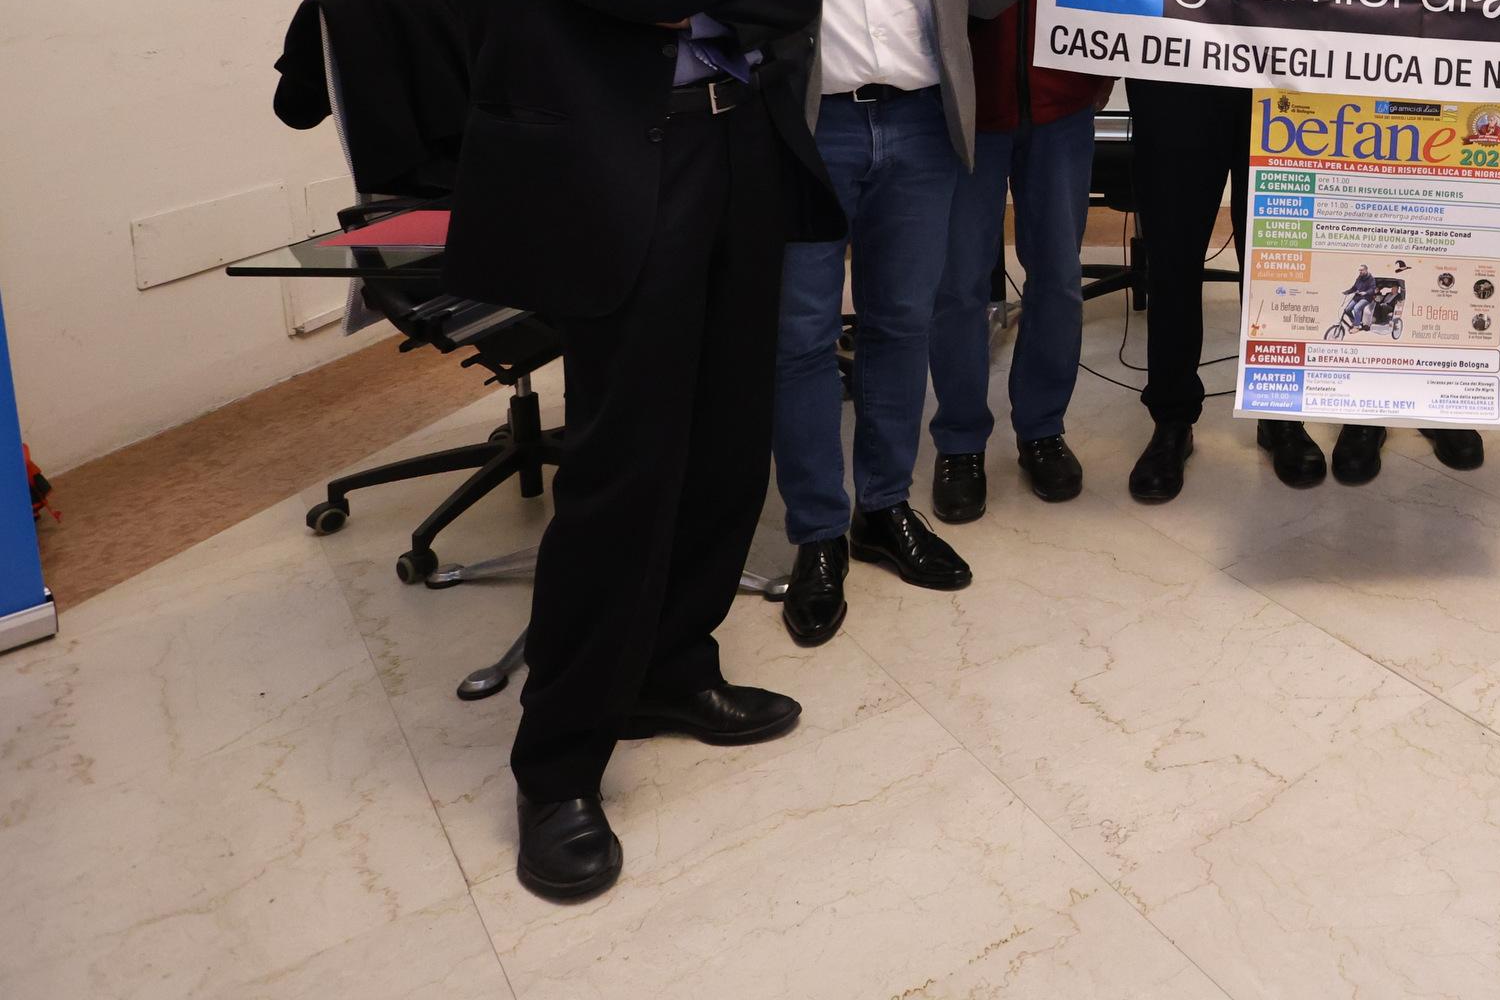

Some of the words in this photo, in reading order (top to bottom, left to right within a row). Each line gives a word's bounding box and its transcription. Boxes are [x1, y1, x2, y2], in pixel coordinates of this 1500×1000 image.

[1050, 25, 1130, 62] CASA
[1141, 35, 1191, 67] DEI
[1202, 41, 1335, 80] RISVEGLI
[1344, 51, 1423, 84] LUCA
[1433, 56, 1473, 88] DE
[1258, 98, 1457, 163] befane
[1268, 158, 1323, 169] SOLIDARIETÀ
[1325, 162, 1342, 170] PER
[1344, 163, 1355, 171] LA
[1357, 164, 1380, 173] CASA
[1381, 166, 1396, 174] DEI
[1398, 167, 1436, 176] RISVEGLI
[1438, 168, 1460, 177] LUCA
[1461, 169, 1473, 177] DE
[1261, 172, 1311, 183] DOMENICA
[1260, 182, 1266, 190] 4
[1267, 183, 1311, 192] GENNAIO
[1358, 187, 1397, 195] RISVEGLI
[1398, 189, 1420, 197] LUCA
[1422, 190, 1434, 198] DE
[1435, 190, 1464, 199] NIGRIS
[1267, 197, 1302, 207] LUNEDÌ
[1258, 207, 1264, 215] 5
[1266, 207, 1309, 217] GENNAIO
[1355, 203, 1399, 212] OSPEDALE
[1401, 205, 1445, 214] MAGGIORE
[1343, 211, 1373, 219] pediatria
[1379, 212, 1409, 221] chirurgia
[1410, 213, 1443, 222] pediatrica
[1265, 221, 1300, 230] LUNEDÌ
[1316, 223, 1340, 231] Centro
[1341, 225, 1388, 234] Commerciale
[1389, 227, 1419, 236] Vialarga
[1425, 229, 1448, 238] Spazio
[1450, 231, 1472, 239] Conad
[1257, 230, 1263, 238] 5
[1265, 231, 1308, 240] GENNAIO
[1329, 233, 1360, 241] BEFANA
[1378, 235, 1406, 243] BUONA
[1408, 236, 1424, 244] DEL
[1426, 238, 1455, 246] MONDO
[1411, 245, 1447, 253] Fantateatro
[1260, 251, 1303, 262] MARTEDÌ
[1255, 262, 1261, 270] 6
[1263, 262, 1306, 271] GENNAIO
[1271, 302, 1279, 311] La
[1280, 302, 1301, 312] Befana
[1302, 304, 1319, 313] arriva
[1411, 301, 1423, 317] La
[1426, 305, 1459, 321] Befana
[1254, 343, 1297, 354] MARTEDÌ
[1250, 354, 1256, 362] 6
[1258, 355, 1300, 364] GENNAIO
[1307, 355, 1316, 363] La
[1318, 356, 1350, 364] BEFANA
[1352, 357, 1415, 366] ALL'IPPODROMO
[1416, 359, 1458, 368] Arcoveggio
[1459, 360, 1490, 369] Bologna
[1253, 371, 1296, 382] MARTEDÌ
[1248, 383, 1254, 391] 6
[1256, 383, 1299, 392] GENNAIO
[1251, 400, 1268, 408] Gran
[1269, 401, 1293, 409] finale!
[1305, 398, 1319, 406] LA
[1320, 398, 1357, 407] REGINA
[1360, 399, 1390, 409] DELLE
[1392, 400, 1416, 410] NEVI
